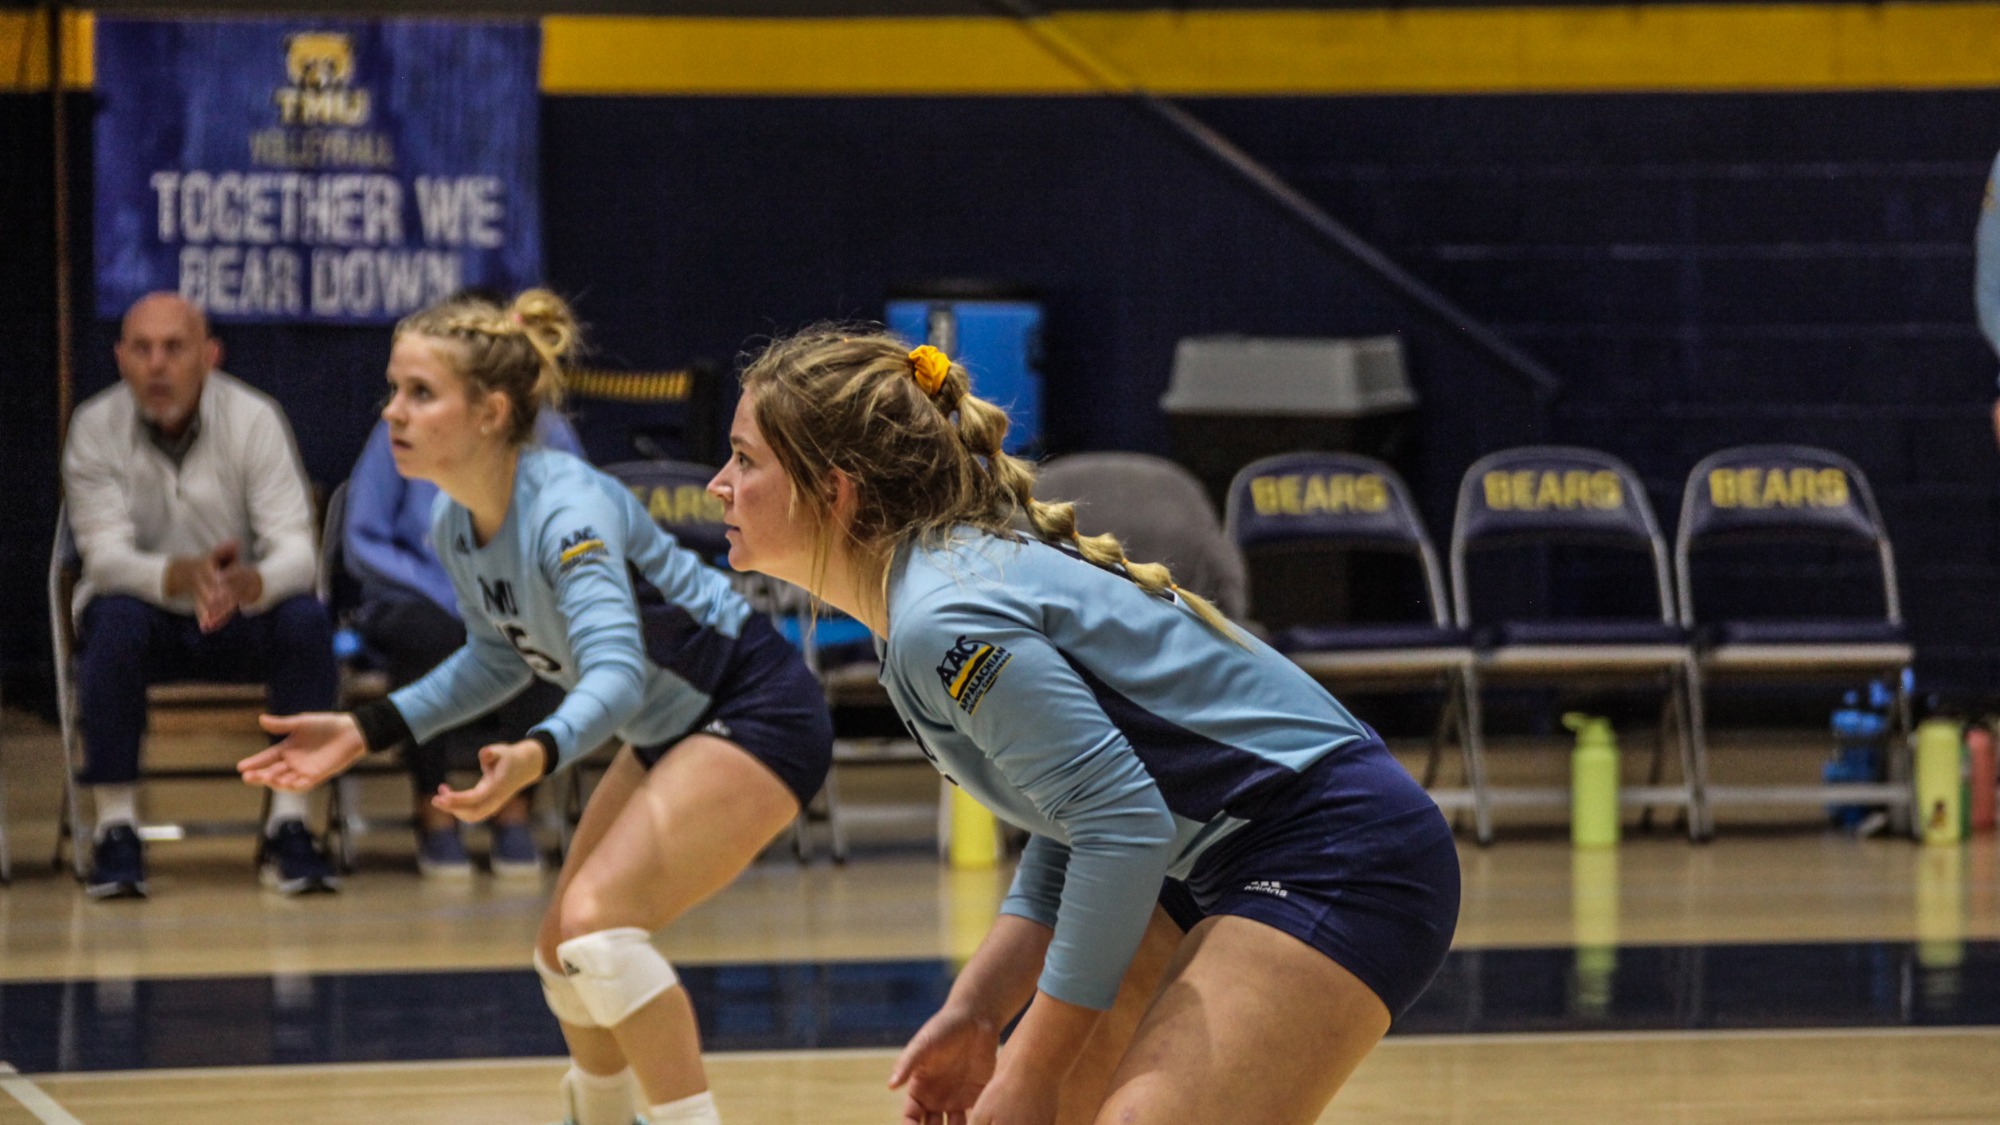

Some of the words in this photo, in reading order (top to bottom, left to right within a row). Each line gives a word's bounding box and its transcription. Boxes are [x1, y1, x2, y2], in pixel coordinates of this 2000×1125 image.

[275, 88, 370, 126] TMU
[151, 170, 403, 243] TOGETHER
[416, 174, 504, 248] WE
[178, 248, 300, 315] BEAR
[311, 248, 463, 317] DOWN
[1250, 474, 1387, 516] BEARS
[1484, 469, 1623, 511] BEARS
[1709, 467, 1849, 509] BEARS
[936, 635, 978, 688] AAC
[959, 646, 1007, 711] APPALACHIAN
[1244, 885, 1288, 898] adidas
